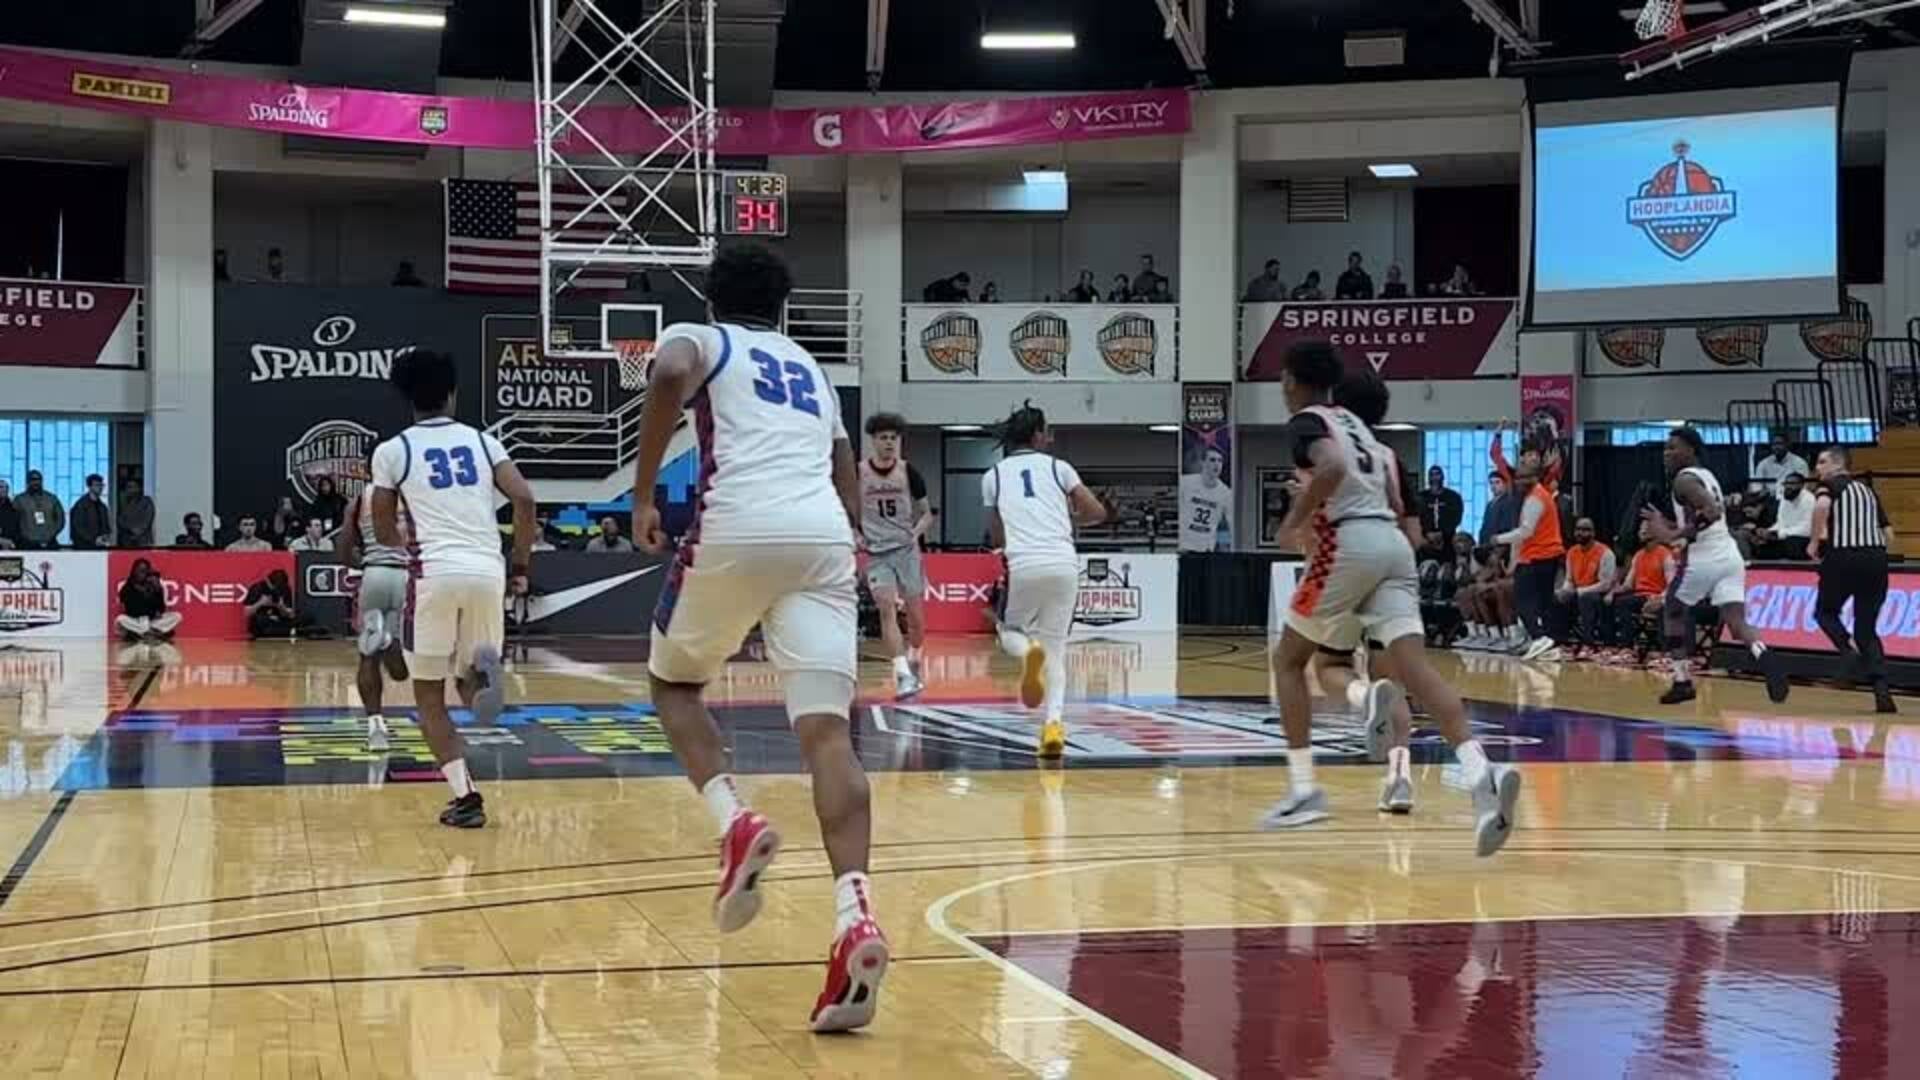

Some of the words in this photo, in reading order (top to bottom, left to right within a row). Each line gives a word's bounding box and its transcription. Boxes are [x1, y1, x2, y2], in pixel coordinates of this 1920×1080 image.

[78, 77, 165, 101] PANINI
[248, 103, 328, 128] SPALDING
[1073, 100, 1169, 122] VKTRY
[737, 177, 784, 196] 4:23
[735, 199, 775, 231] 34
[1632, 198, 1731, 216] HOOPLANDIA
[0, 287, 95, 310] FIELD
[1283, 306, 1475, 328] SPRINGFIELD
[1329, 332, 1426, 345] COLLEGE
[250, 343, 416, 382] SPALDIN
[497, 368, 593, 384] NATIONAL
[749, 346, 821, 418] 32
[497, 385, 593, 408] GUARD
[424, 446, 479, 489] 33
[1020, 469, 1035, 498] 1
[877, 499, 897, 518] 15
